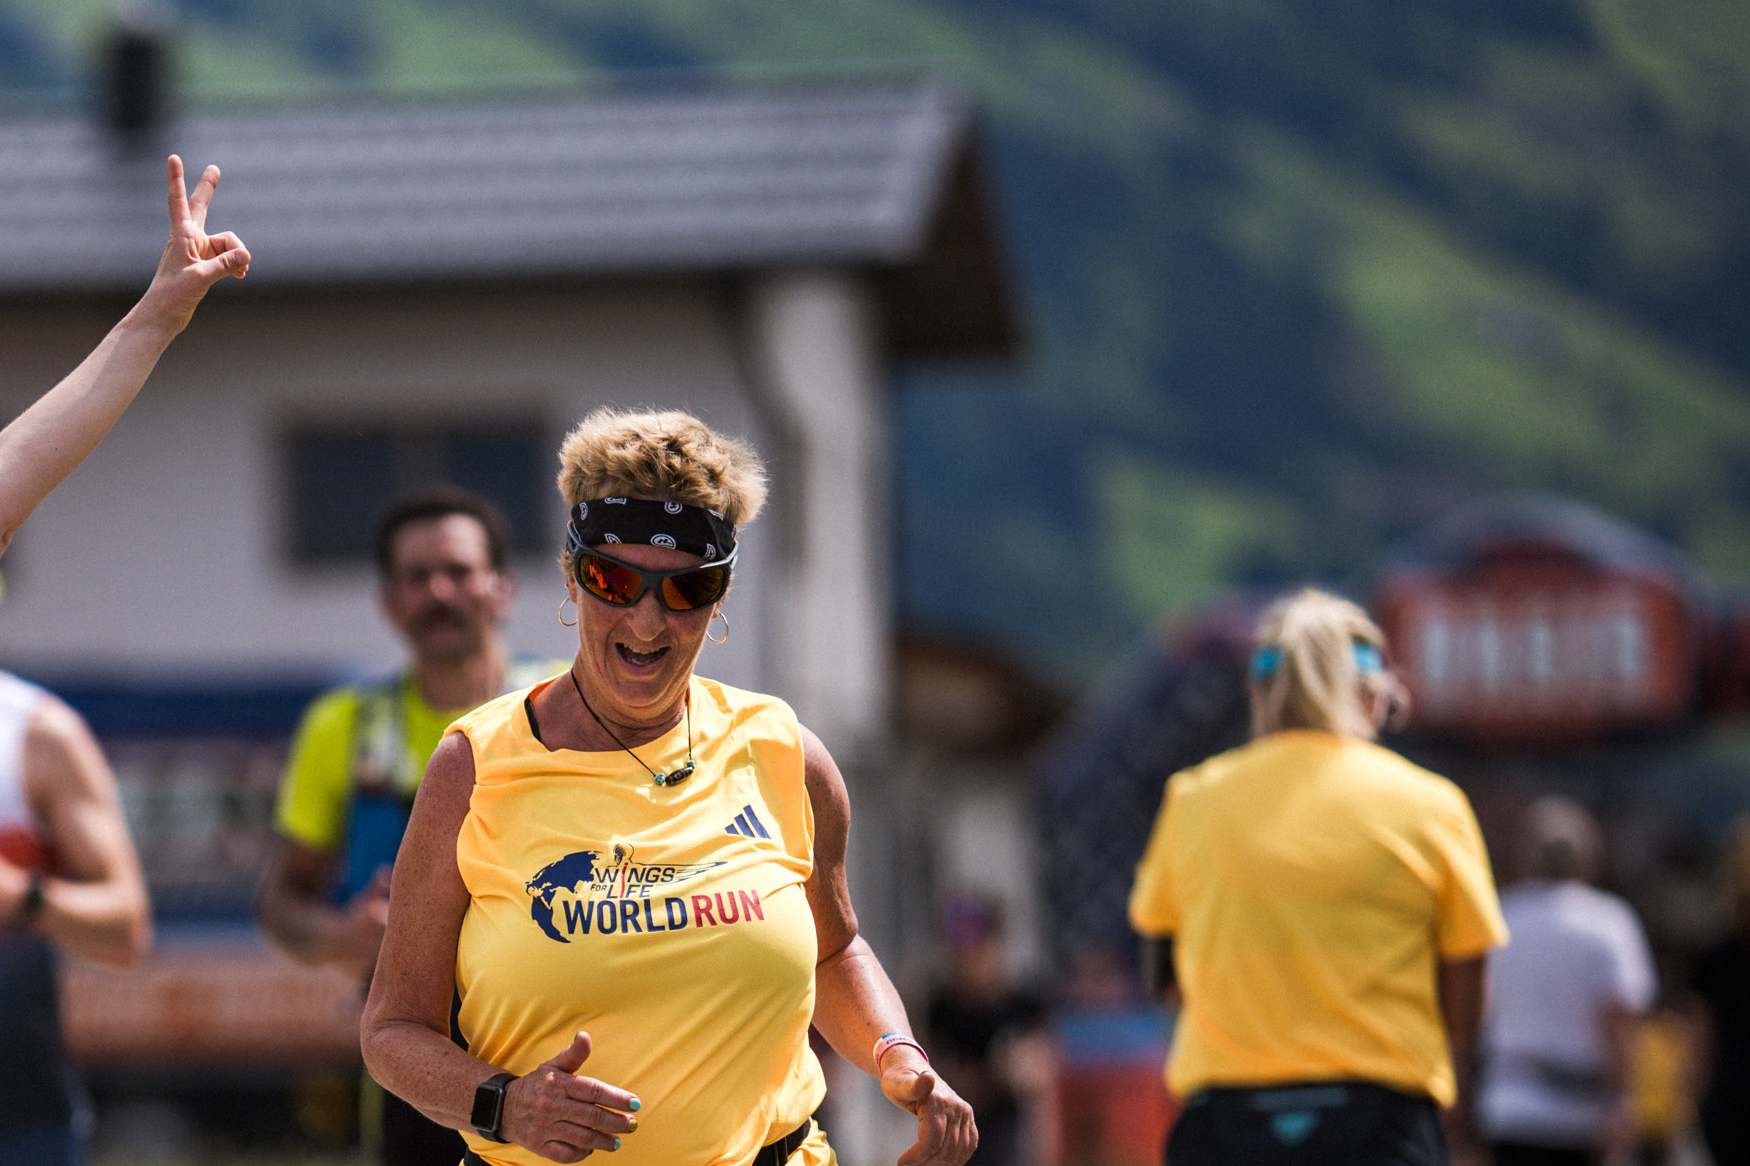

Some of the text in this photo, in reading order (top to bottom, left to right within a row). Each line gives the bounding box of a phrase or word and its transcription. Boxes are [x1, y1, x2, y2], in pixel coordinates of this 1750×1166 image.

[594, 862, 676, 884] WINGS
[590, 883, 654, 899] FOR LIFE
